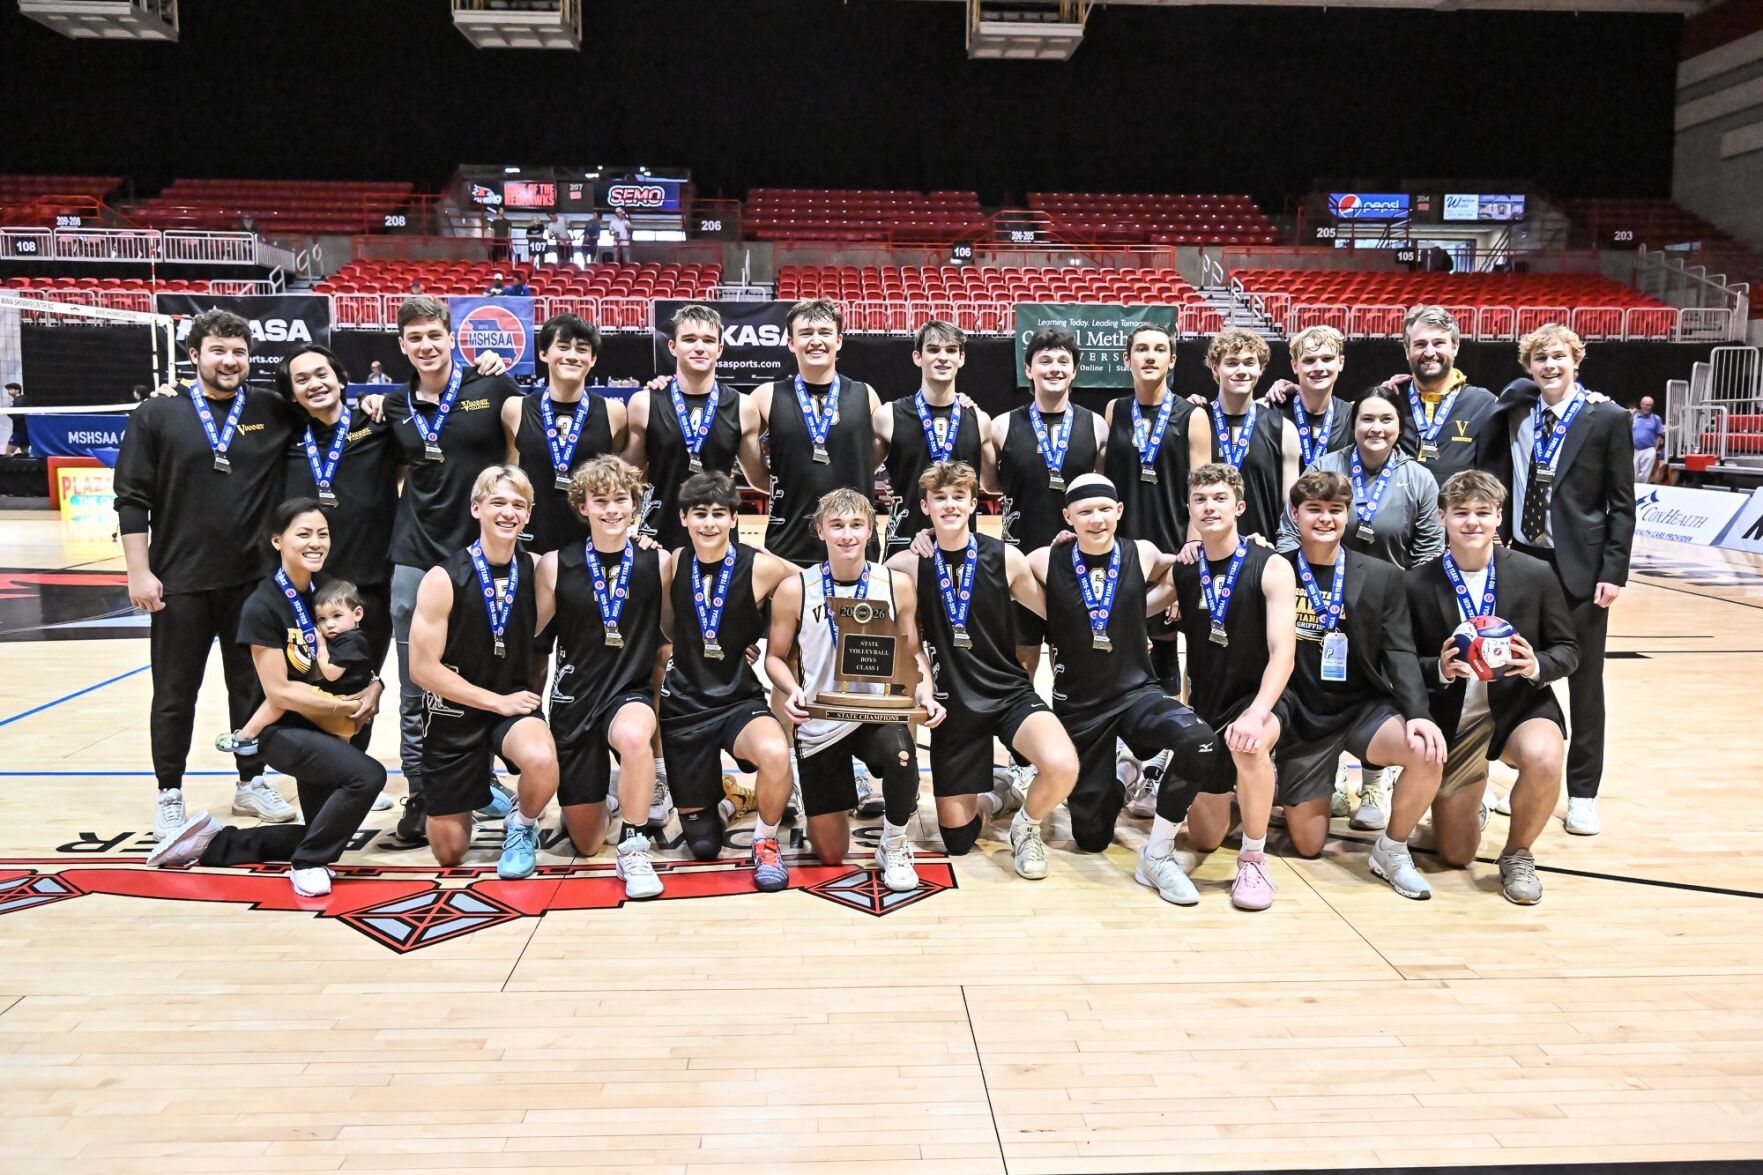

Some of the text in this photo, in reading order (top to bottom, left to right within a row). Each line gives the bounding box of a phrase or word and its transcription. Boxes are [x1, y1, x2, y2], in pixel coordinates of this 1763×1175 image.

[610, 186, 662, 204] SEMO
[1363, 200, 1399, 212] pepsi
[384, 216, 406, 226] 208
[701, 220, 722, 231] 206
[1317, 228, 1336, 238] 205
[1614, 231, 1633, 240] 203
[16, 241, 36, 252] 108
[530, 242, 547, 252] 107
[954, 247, 972, 257] 106
[1398, 252, 1414, 261] 105
[1038, 318, 1066, 328] Learning
[1070, 319, 1089, 327] Today.
[1092, 320, 1118, 328] Leading
[469, 332, 513, 346] MSHSAA
[1456, 420, 1469, 436] V
[68, 432, 118, 444] MSHSAA
[1230, 561, 1238, 576] YEARS
[1449, 568, 1460, 582] YEARS
[720, 570, 729, 585] YEARS
[591, 562, 600, 576] YEARS
[600, 594, 610, 617] 1926-2026
[1081, 578, 1093, 601] 1926-2026
[1308, 584, 1320, 606] 1926-2026
[481, 570, 489, 584] YEARS
[489, 601, 498, 626] 1926-2026
[946, 591, 957, 615] 1926-2026
[1206, 588, 1216, 611] 1926-2026
[294, 600, 308, 624] 1926-2026
[841, 607, 885, 619] 20 26
